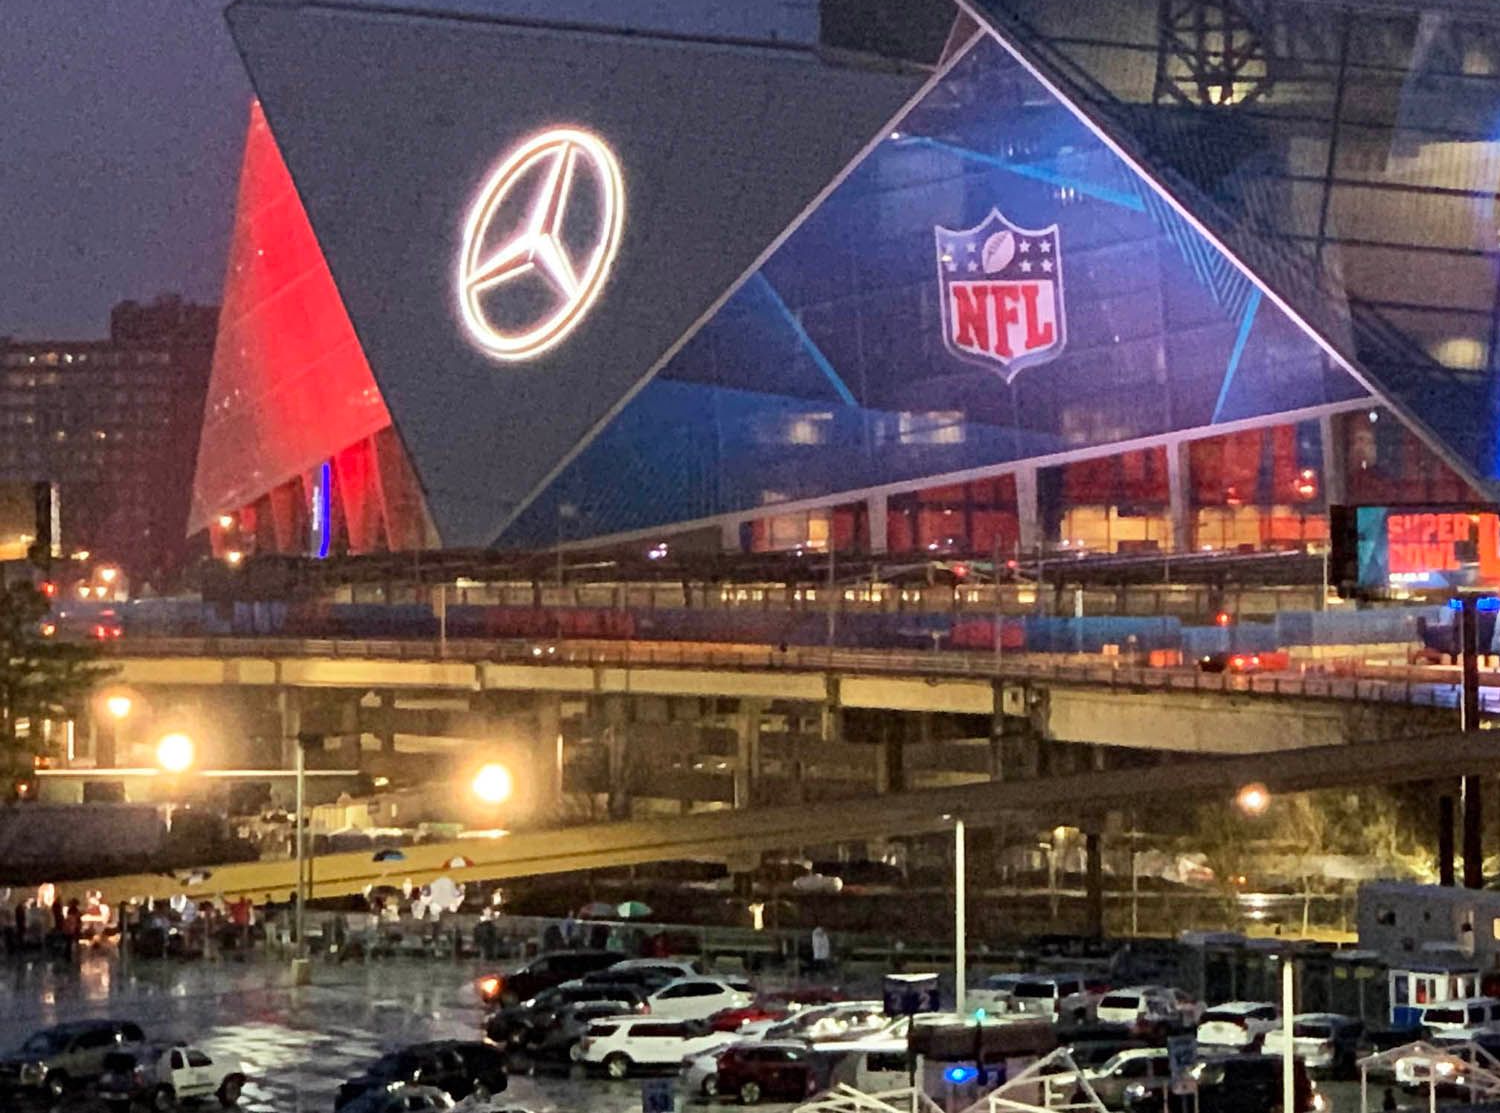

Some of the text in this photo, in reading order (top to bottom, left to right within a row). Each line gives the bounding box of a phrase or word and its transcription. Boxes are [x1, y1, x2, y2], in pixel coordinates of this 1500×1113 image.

[952, 285, 1054, 358] NFL
[1388, 514, 1469, 542] SUPER
[1388, 542, 1461, 571] BOWL
